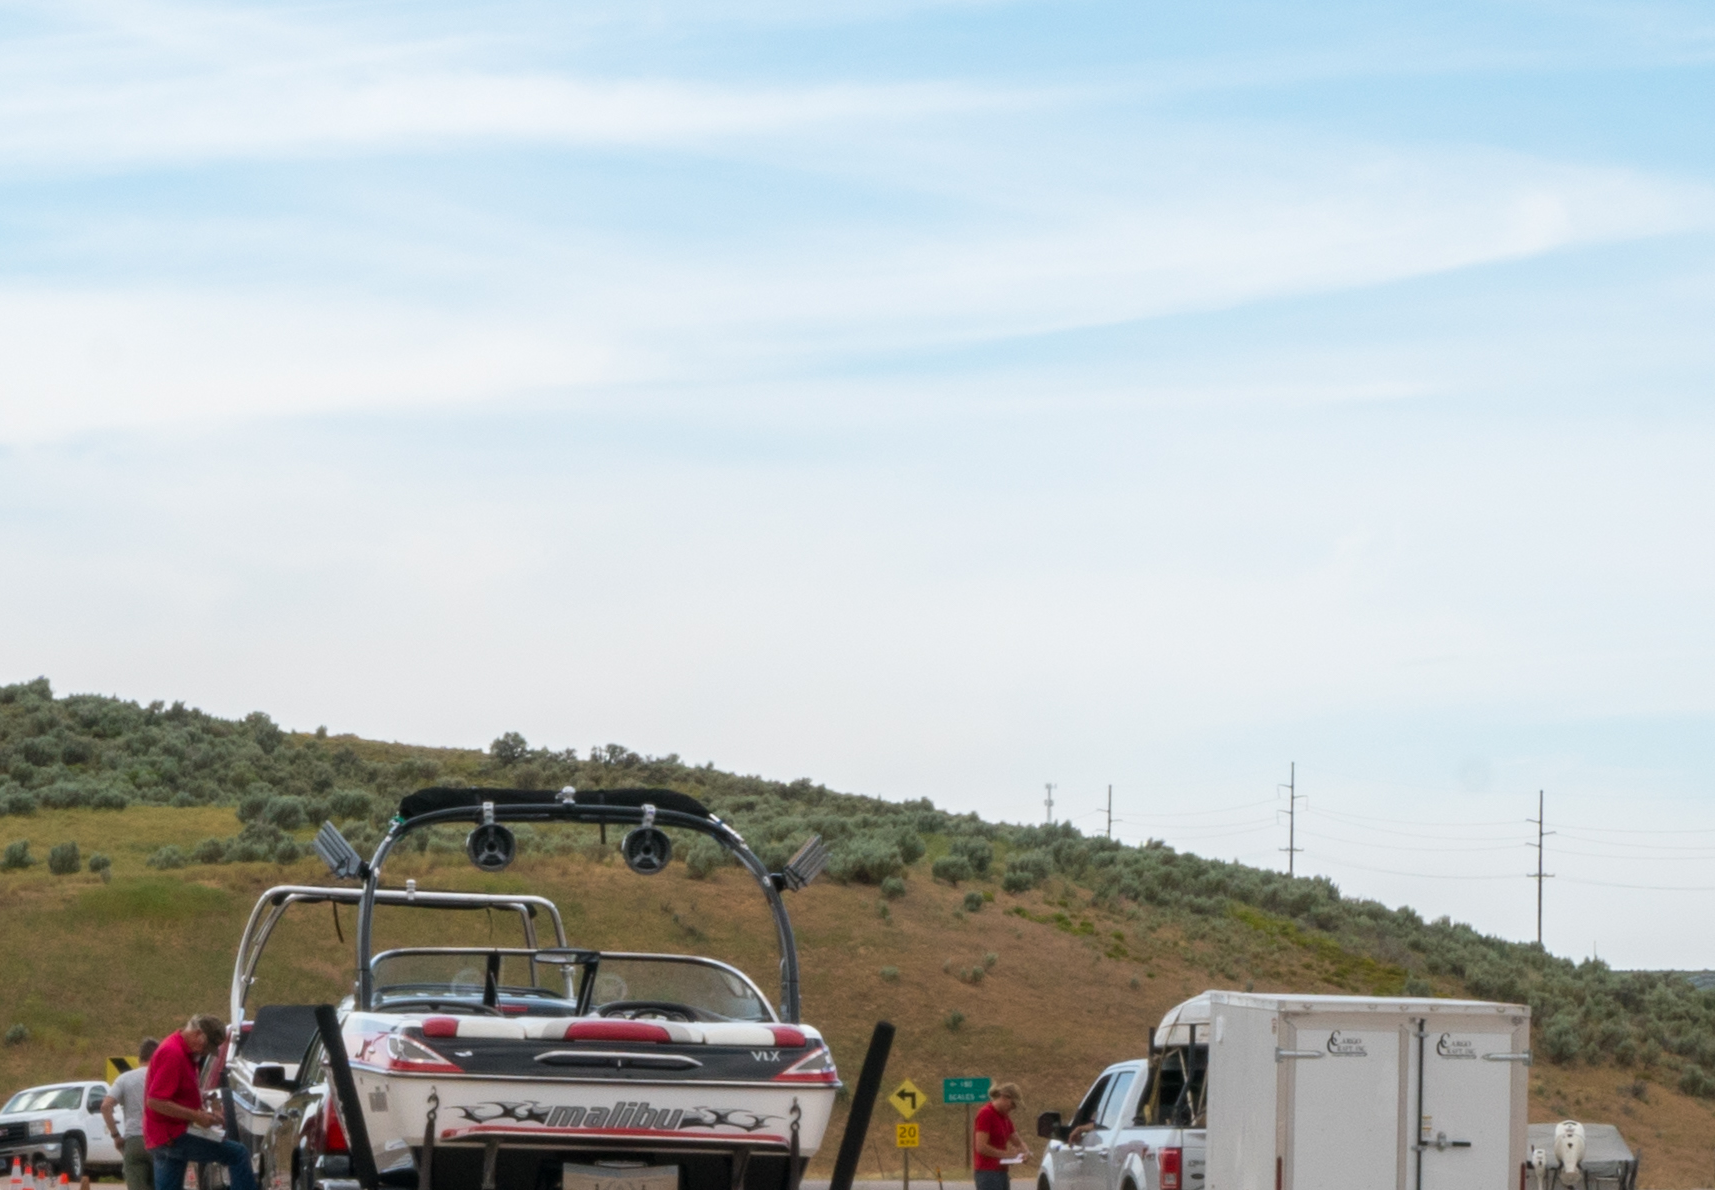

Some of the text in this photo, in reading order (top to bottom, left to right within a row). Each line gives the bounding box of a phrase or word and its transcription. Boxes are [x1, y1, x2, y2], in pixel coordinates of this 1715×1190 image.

[750, 1050, 781, 1062] VLX
[545, 1101, 685, 1130] malibu
[899, 1126, 917, 1138] 20
